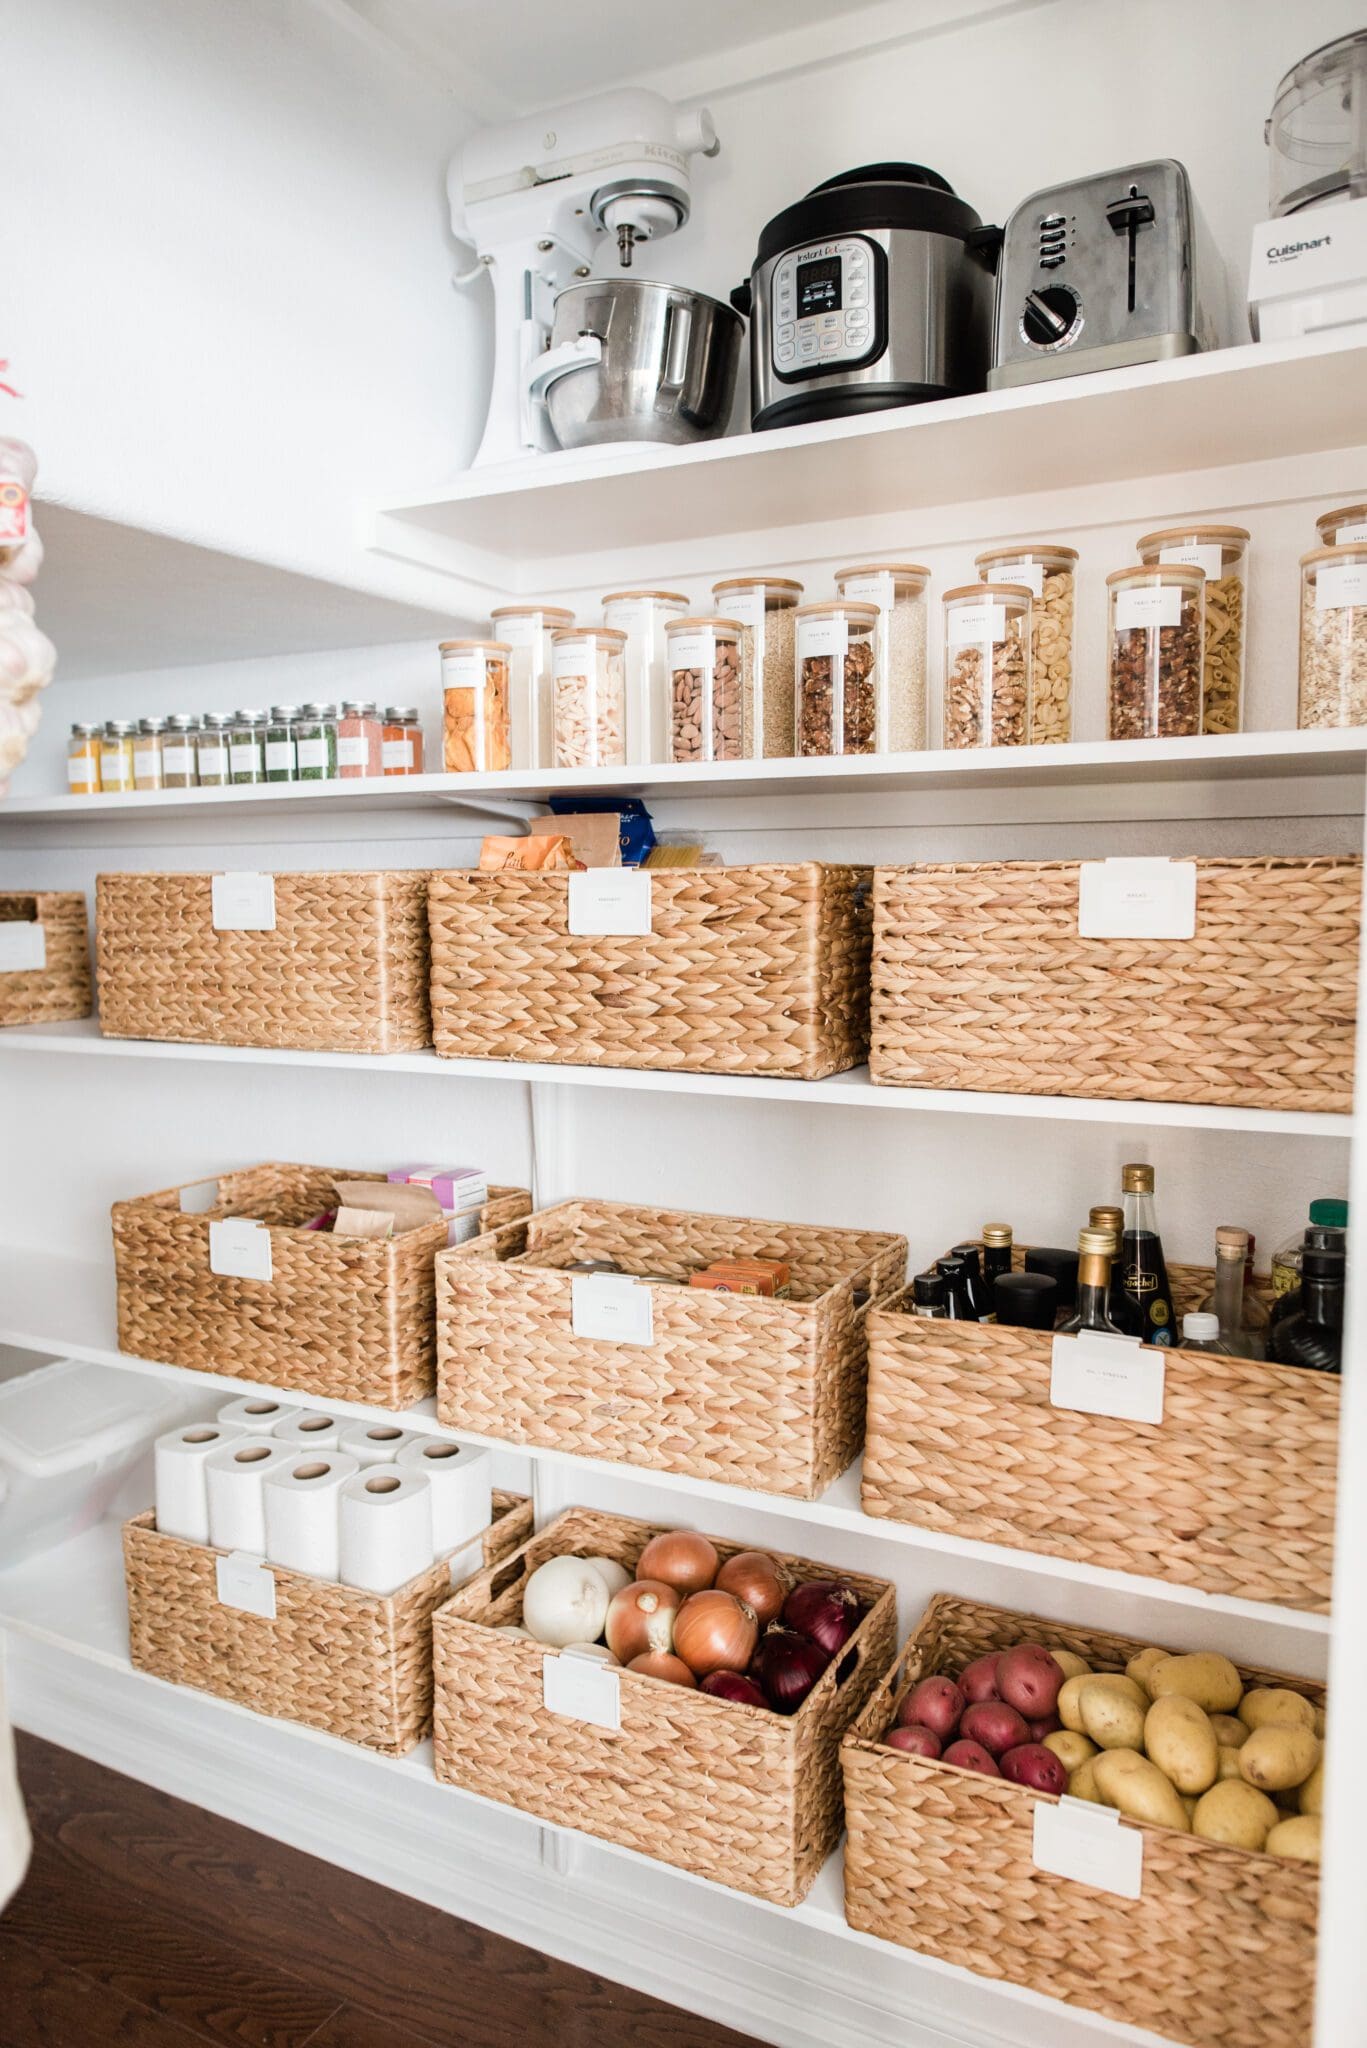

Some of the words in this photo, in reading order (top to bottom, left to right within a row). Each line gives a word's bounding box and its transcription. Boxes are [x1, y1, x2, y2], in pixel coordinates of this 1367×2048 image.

[797, 249, 823, 263] Instant
[825, 246, 839, 256] Pot
[1267, 235, 1331, 259] Cuisinart
